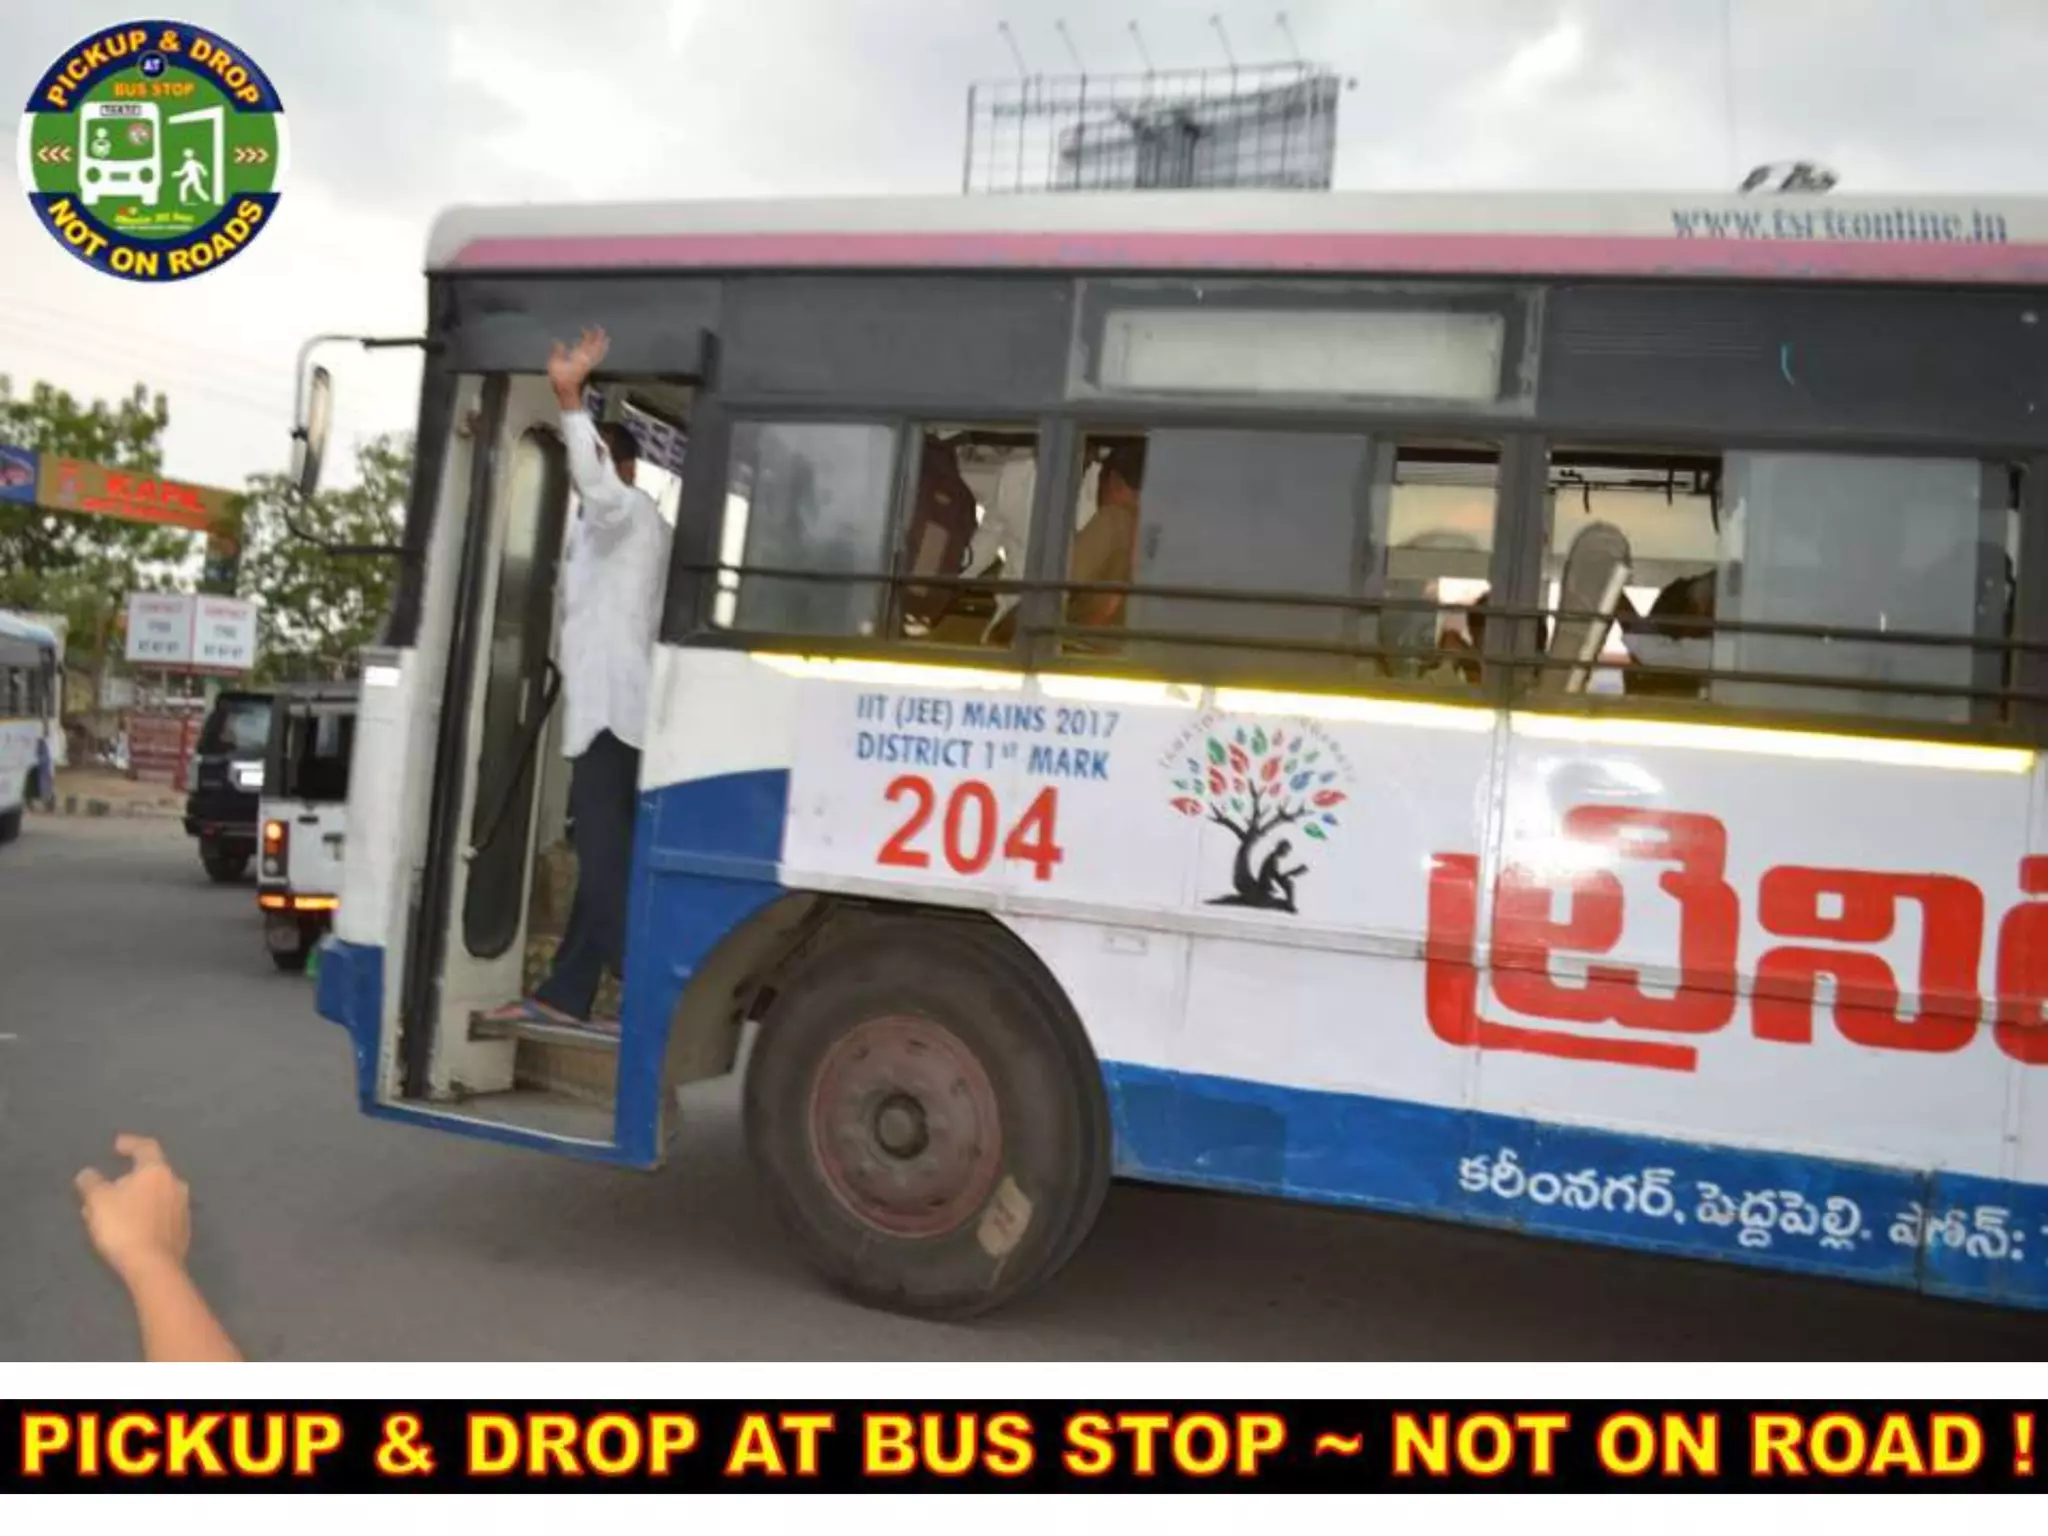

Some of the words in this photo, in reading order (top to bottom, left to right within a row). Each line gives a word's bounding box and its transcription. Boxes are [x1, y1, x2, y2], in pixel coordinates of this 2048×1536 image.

[856, 730, 974, 770] DISTRICT
[1026, 744, 1110, 781] MARK
[857, 694, 888, 720] IIT
[895, 695, 954, 732] (JEE)
[961, 700, 1047, 733] MAINS
[1055, 707, 1121, 739] 2017
[875, 774, 1065, 883] 204
[1425, 803, 2048, 1073] ట్రిని
